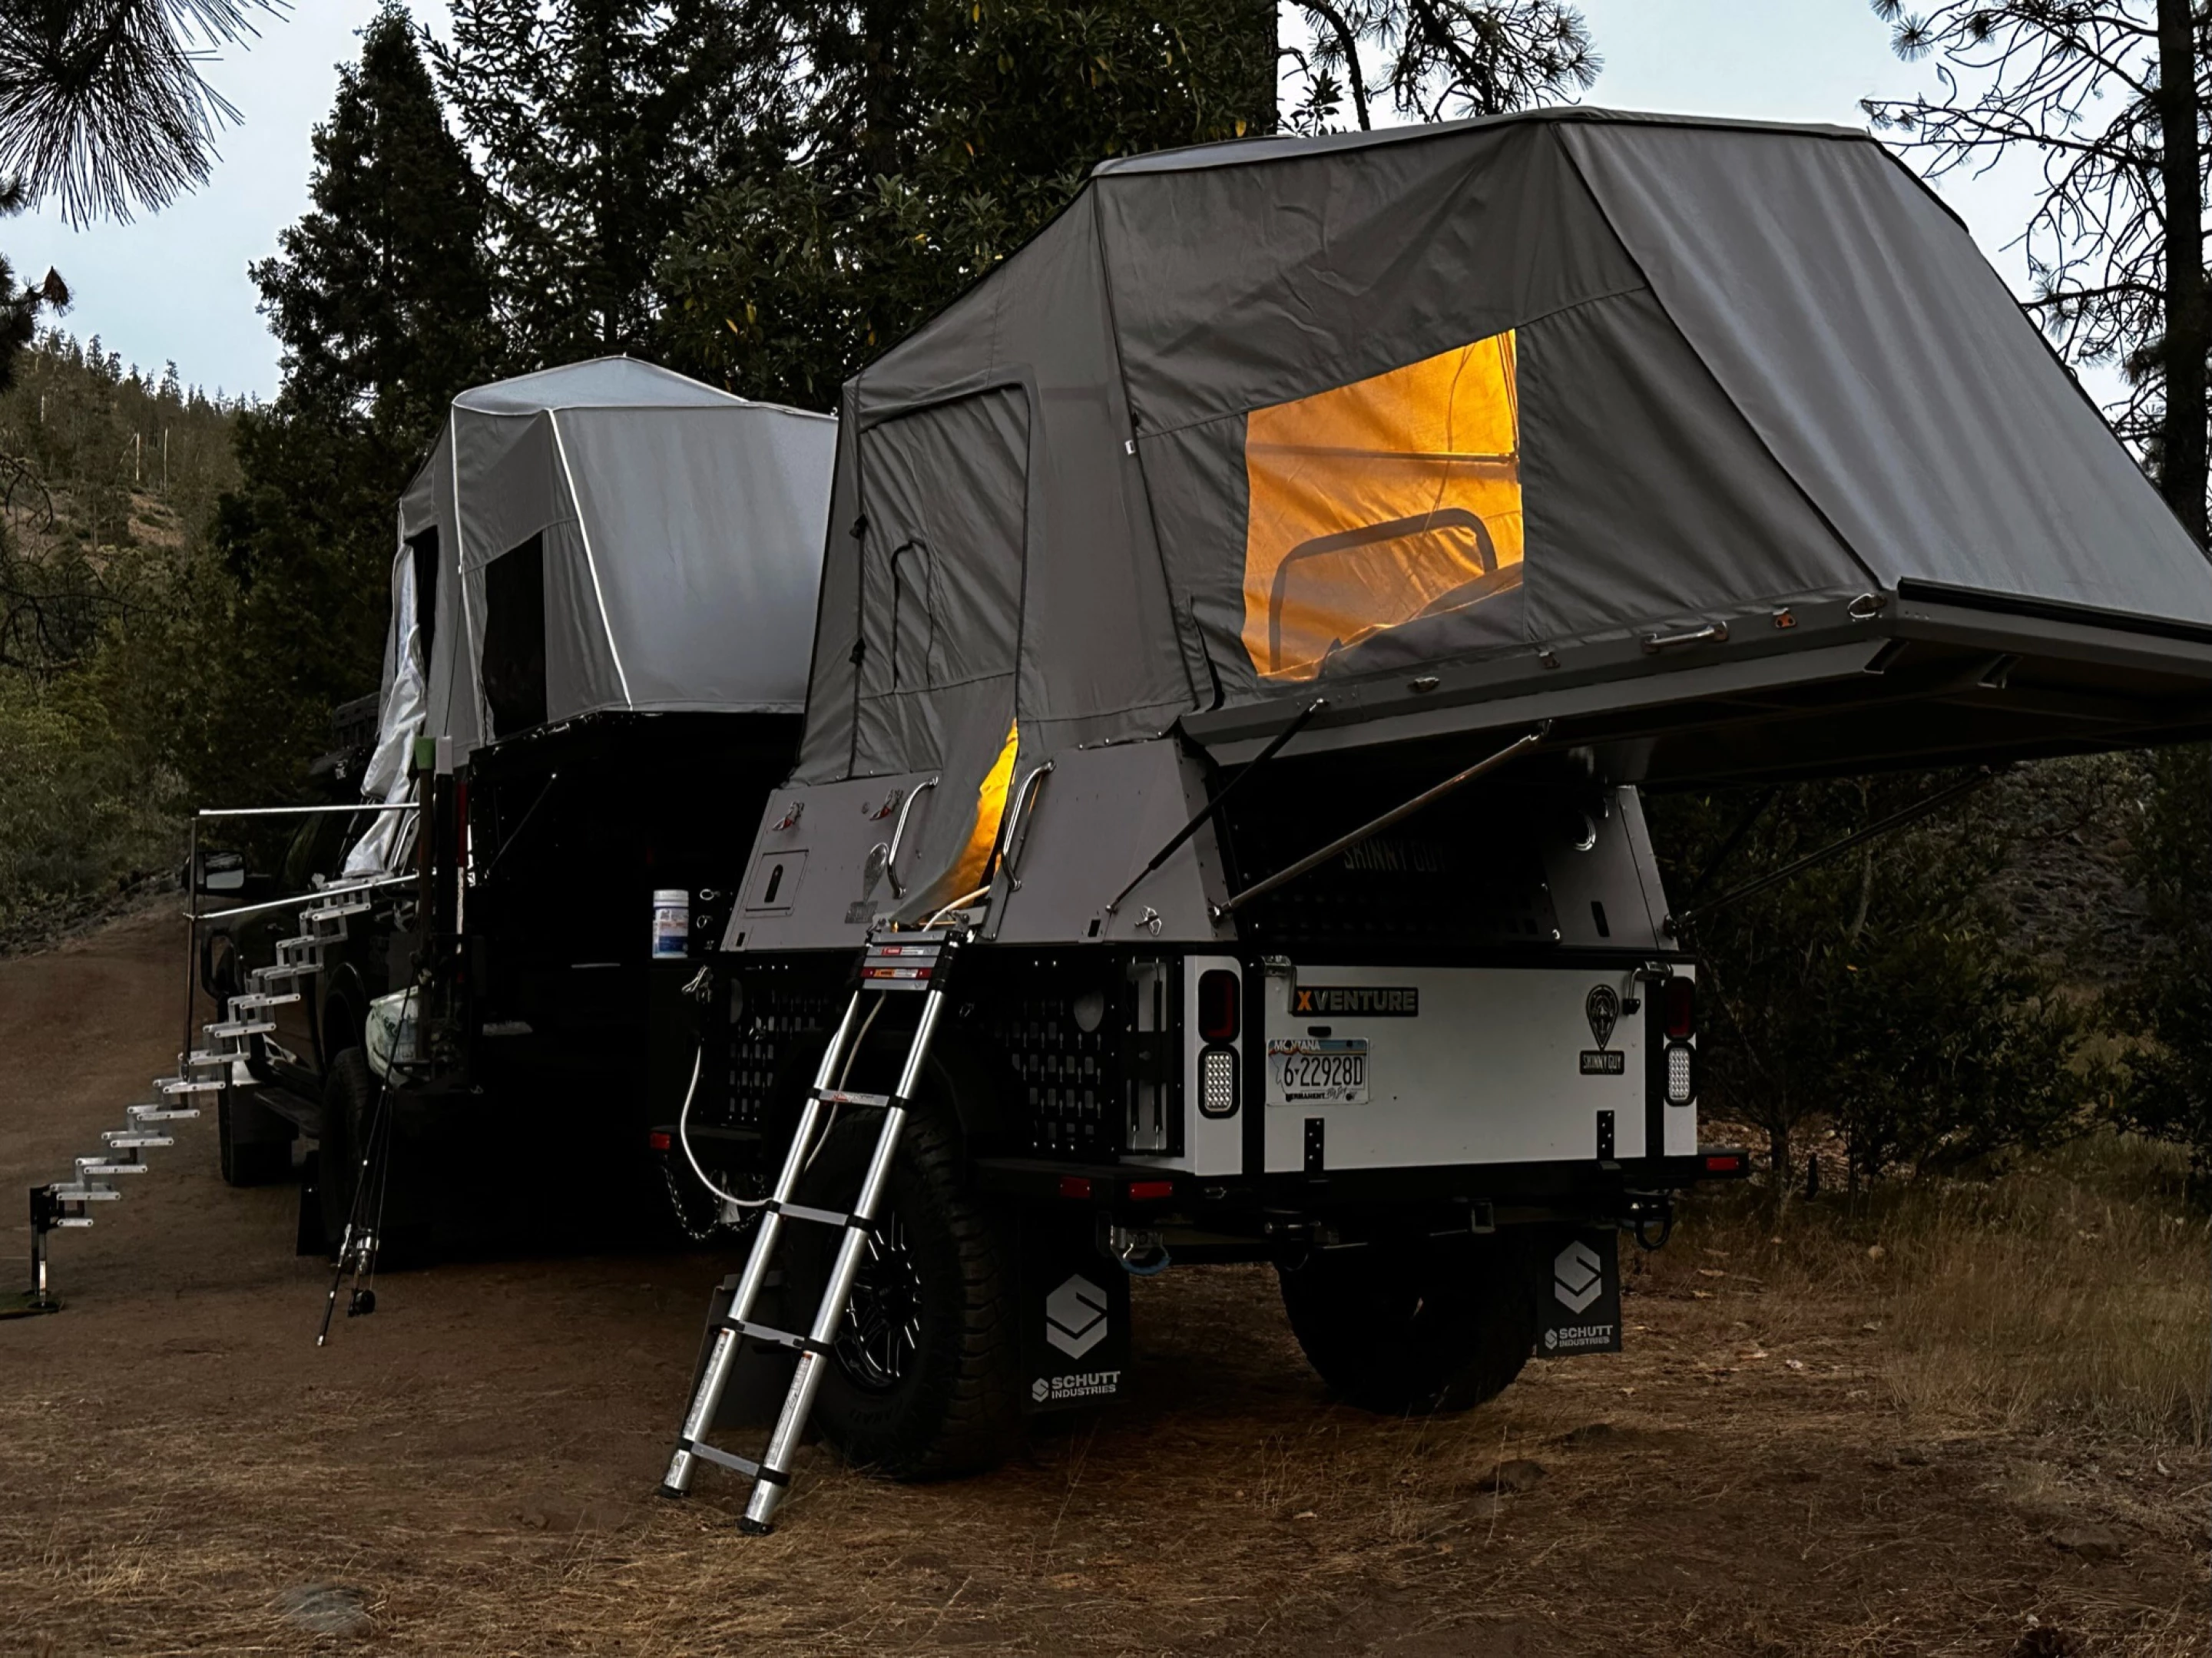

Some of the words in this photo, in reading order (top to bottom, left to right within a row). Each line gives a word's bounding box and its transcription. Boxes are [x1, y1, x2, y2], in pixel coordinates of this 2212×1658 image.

[1343, 839, 1407, 872] SKINNY
[1410, 840, 1445, 874] GUY
[1297, 991, 1416, 1011] XVENTURE
[1559, 1325, 1613, 1339] SCHUTT
[1559, 1336, 1611, 1348] INDUSTRIES
[1051, 1370, 1121, 1389] SCHUTT
[1051, 1384, 1116, 1399] INDUSTRIES
